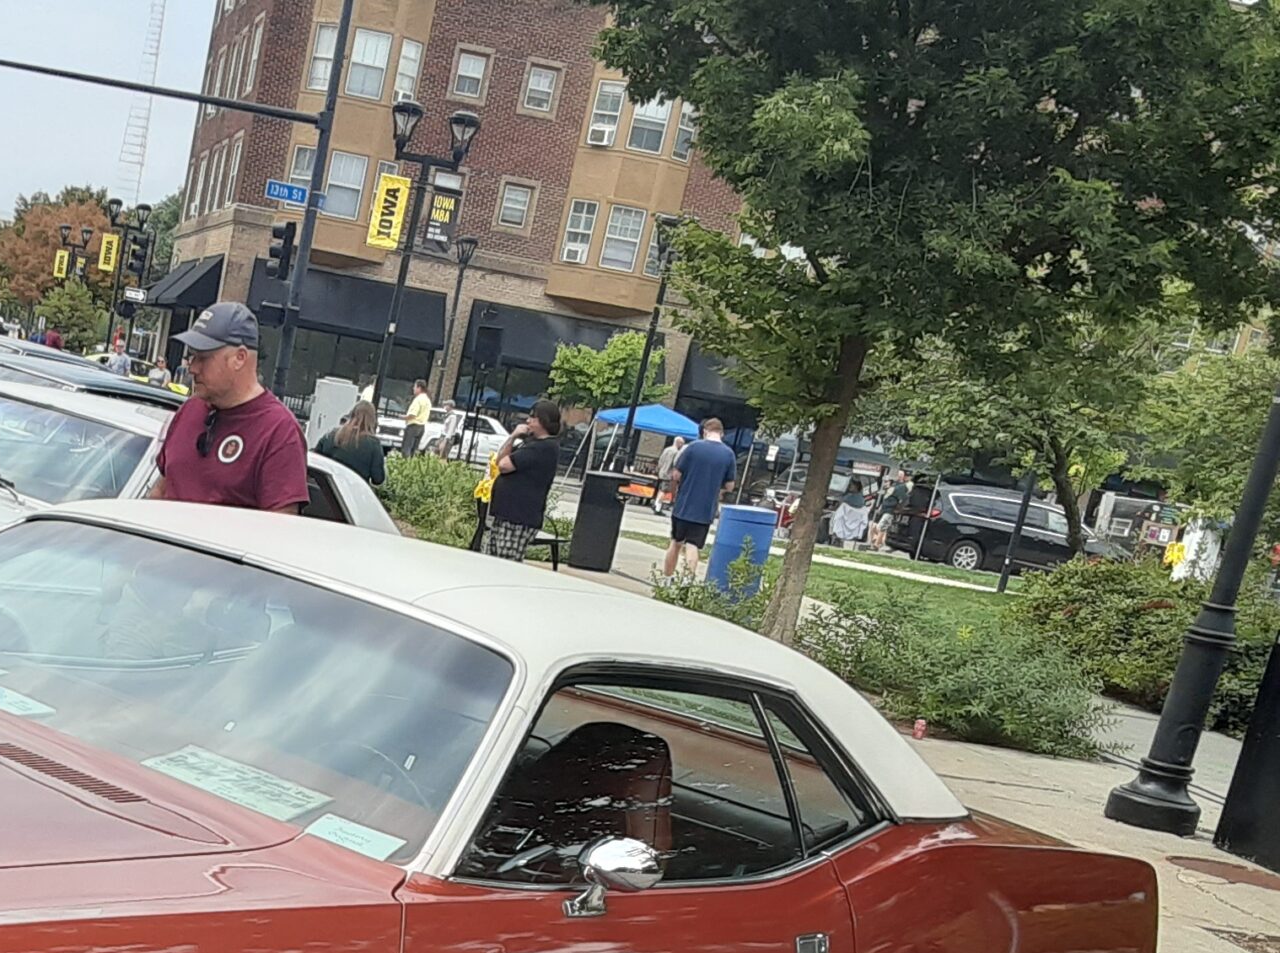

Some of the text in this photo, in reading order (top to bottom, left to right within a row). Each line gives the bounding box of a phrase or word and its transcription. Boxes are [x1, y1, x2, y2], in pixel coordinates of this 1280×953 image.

[269, 183, 303, 201] 13th St
[433, 195, 455, 211] IOWA
[376, 186, 401, 239] IOWA
[430, 208, 451, 224] MBA
